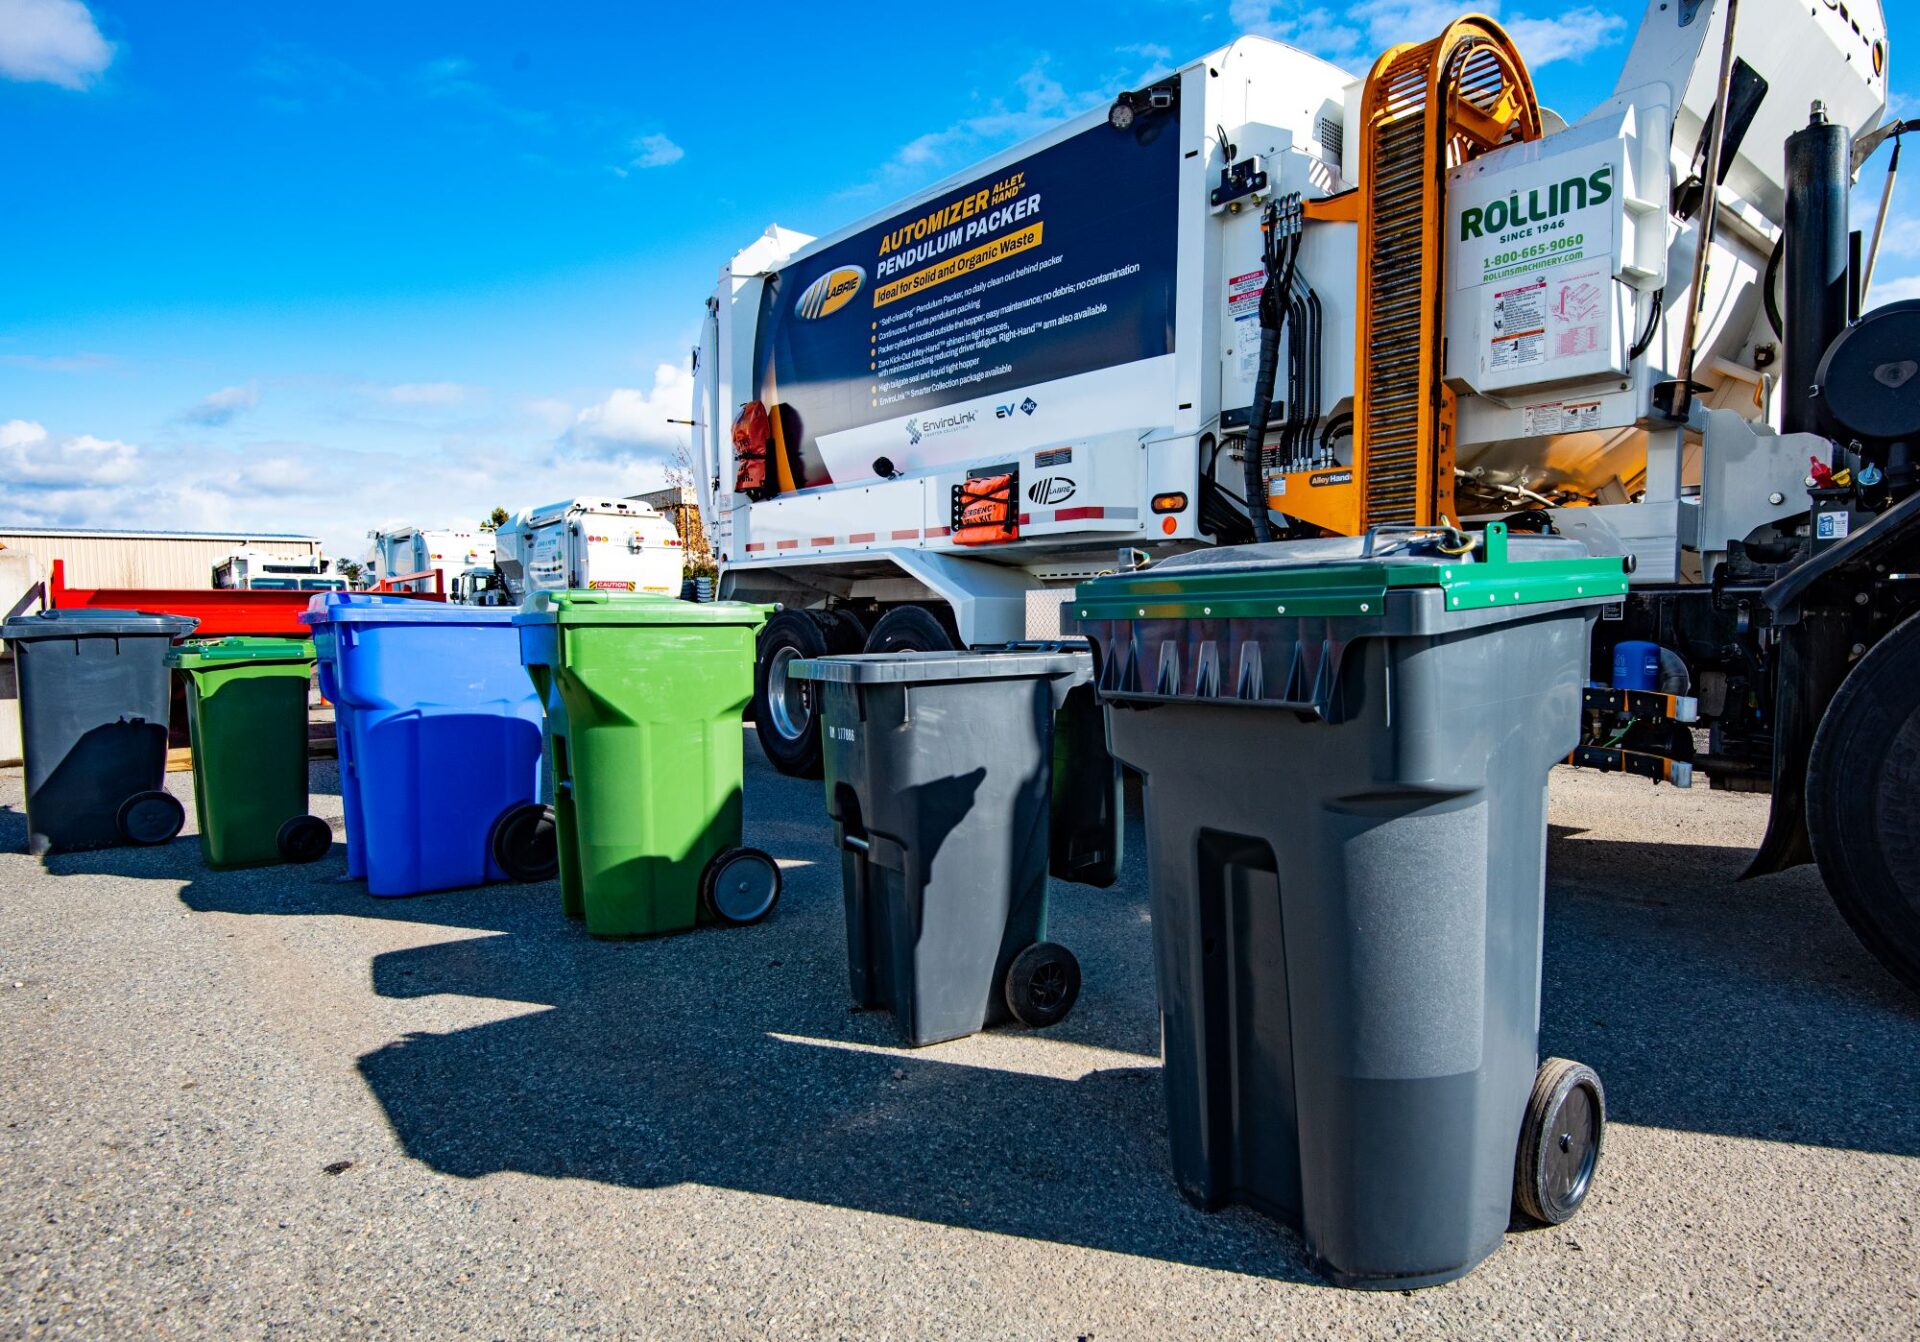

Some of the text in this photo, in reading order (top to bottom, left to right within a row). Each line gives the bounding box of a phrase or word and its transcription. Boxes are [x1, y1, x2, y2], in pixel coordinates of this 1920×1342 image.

[992, 172, 1024, 195] ALLEY
[1460, 167, 1613, 242] ROLLINS
[876, 193, 1042, 279] PENDULUM PACKER
[878, 189, 990, 256] AUTOMIZER
[1499, 219, 1565, 244] SINCE 1946
[877, 231, 1035, 303] Ideal for Solid and Organic Waste
[1483, 233, 1584, 269] 1-800-665-9060
[916, 298, 942, 314] Pendulum
[943, 290, 964, 304] Packer,
[964, 289, 973, 297] no
[972, 281, 987, 293] daily
[987, 275, 1004, 288] clean
[1004, 271, 1015, 282] out
[1016, 262, 1039, 278] behind
[1039, 254, 1064, 272] packer
[894, 335, 916, 350] cylinders
[915, 329, 935, 342] located
[934, 322, 954, 335] outside
[954, 319, 964, 329] the
[985, 309, 1000, 320] easy
[1042, 292, 1052, 301] no
[1052, 283, 1076, 298] debris;
[1076, 281, 1086, 290] no
[1086, 263, 1140, 287] contamination
[915, 317, 929, 328] route
[929, 308, 957, 325] pendulum
[957, 299, 981, 315] packing
[878, 358, 889, 369] Zero
[889, 352, 912, 365] Kick-Out
[946, 335, 965, 347] shines
[971, 327, 985, 340] tight
[985, 321, 1010, 336] spaces,
[889, 361, 914, 375] minimized
[934, 348, 959, 361] reducing
[958, 342, 975, 353] driver
[975, 336, 998, 349] fatigue.
[1043, 318, 1057, 330] arm
[1057, 313, 1073, 325] also
[1073, 303, 1108, 321] available
[879, 357, 980, 392] High tailgate seal and liquid tight hopper
[910, 385, 931, 397] Smarter
[931, 378, 959, 392] Collection
[959, 372, 984, 386] package
[984, 364, 1013, 378] available
[995, 403, 1015, 419] EV
[1311, 473, 1350, 485] Alley Hand
